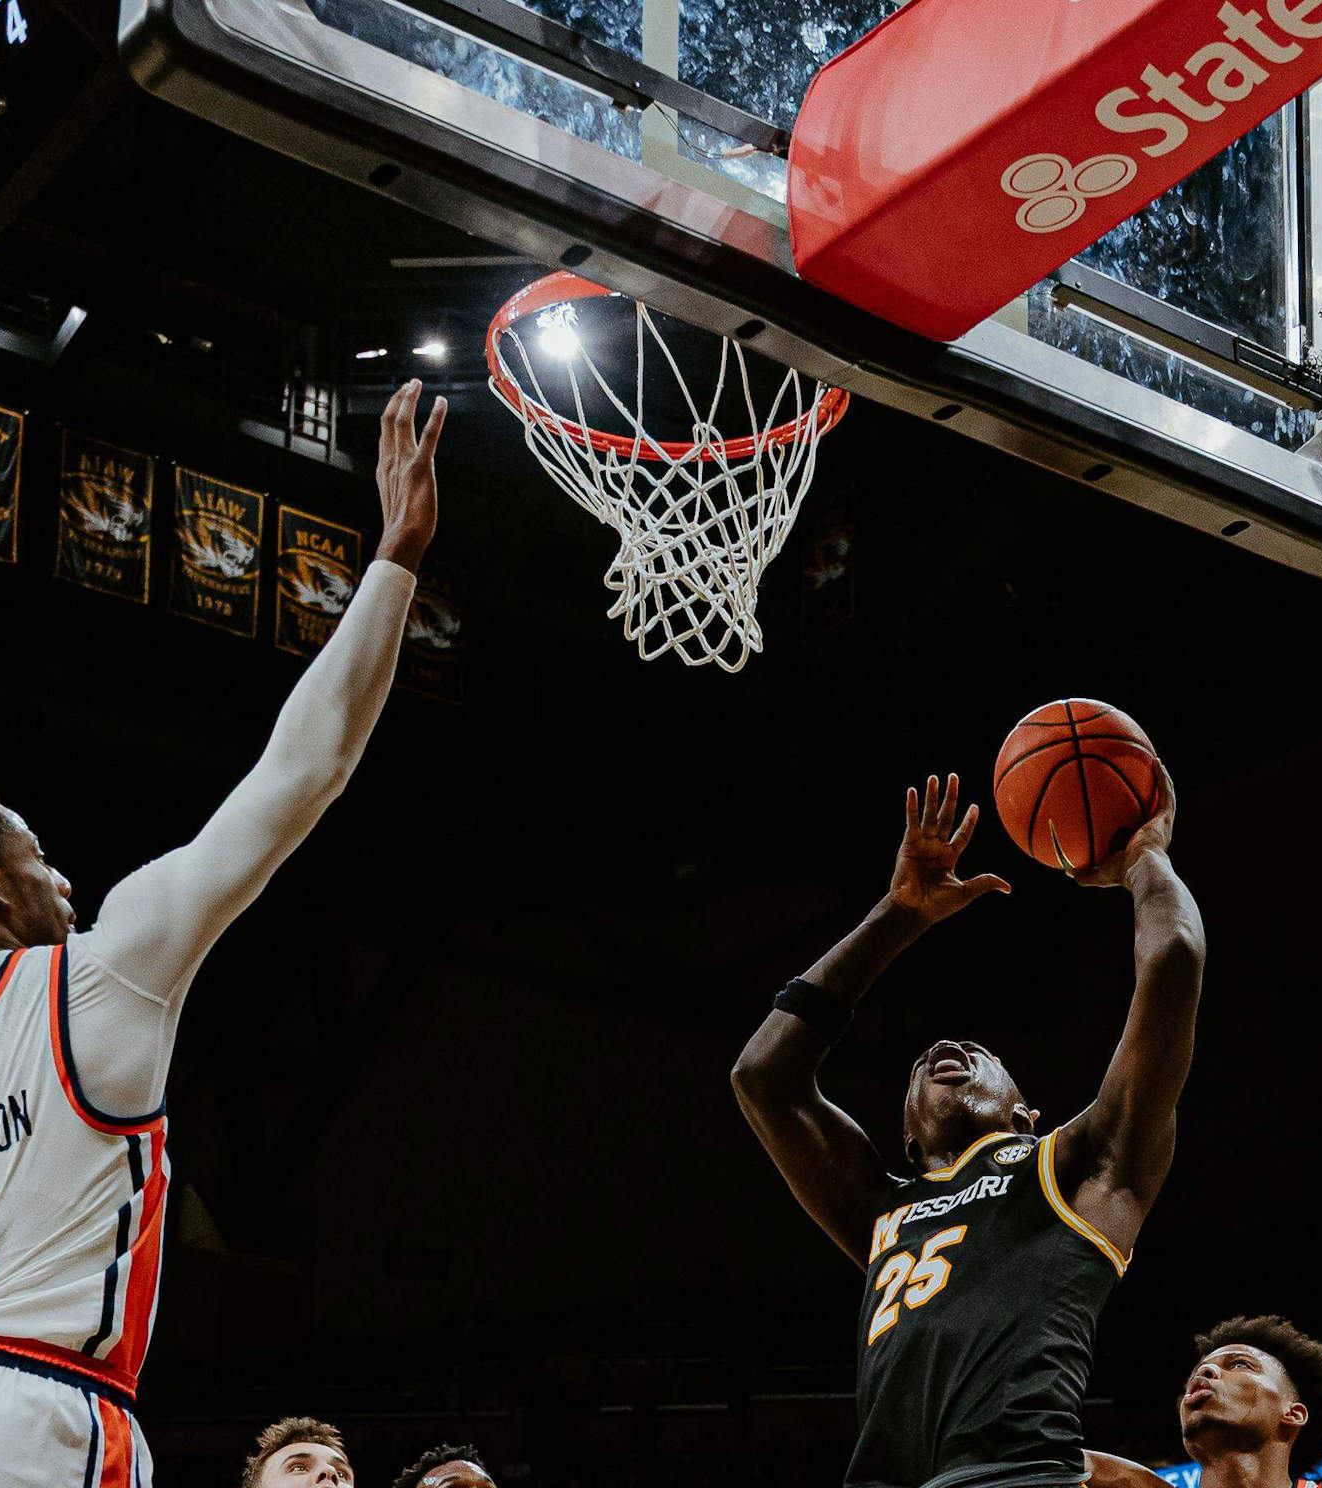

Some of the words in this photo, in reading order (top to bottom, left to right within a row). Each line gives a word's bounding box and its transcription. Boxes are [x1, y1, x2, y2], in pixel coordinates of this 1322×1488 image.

[6, 0, 27, 44] 4
[296, 530, 345, 560] NCAA
[997, 1146, 1030, 1164] SEC
[870, 1174, 1013, 1264] MISSOURI
[868, 1225, 968, 1346] 25
